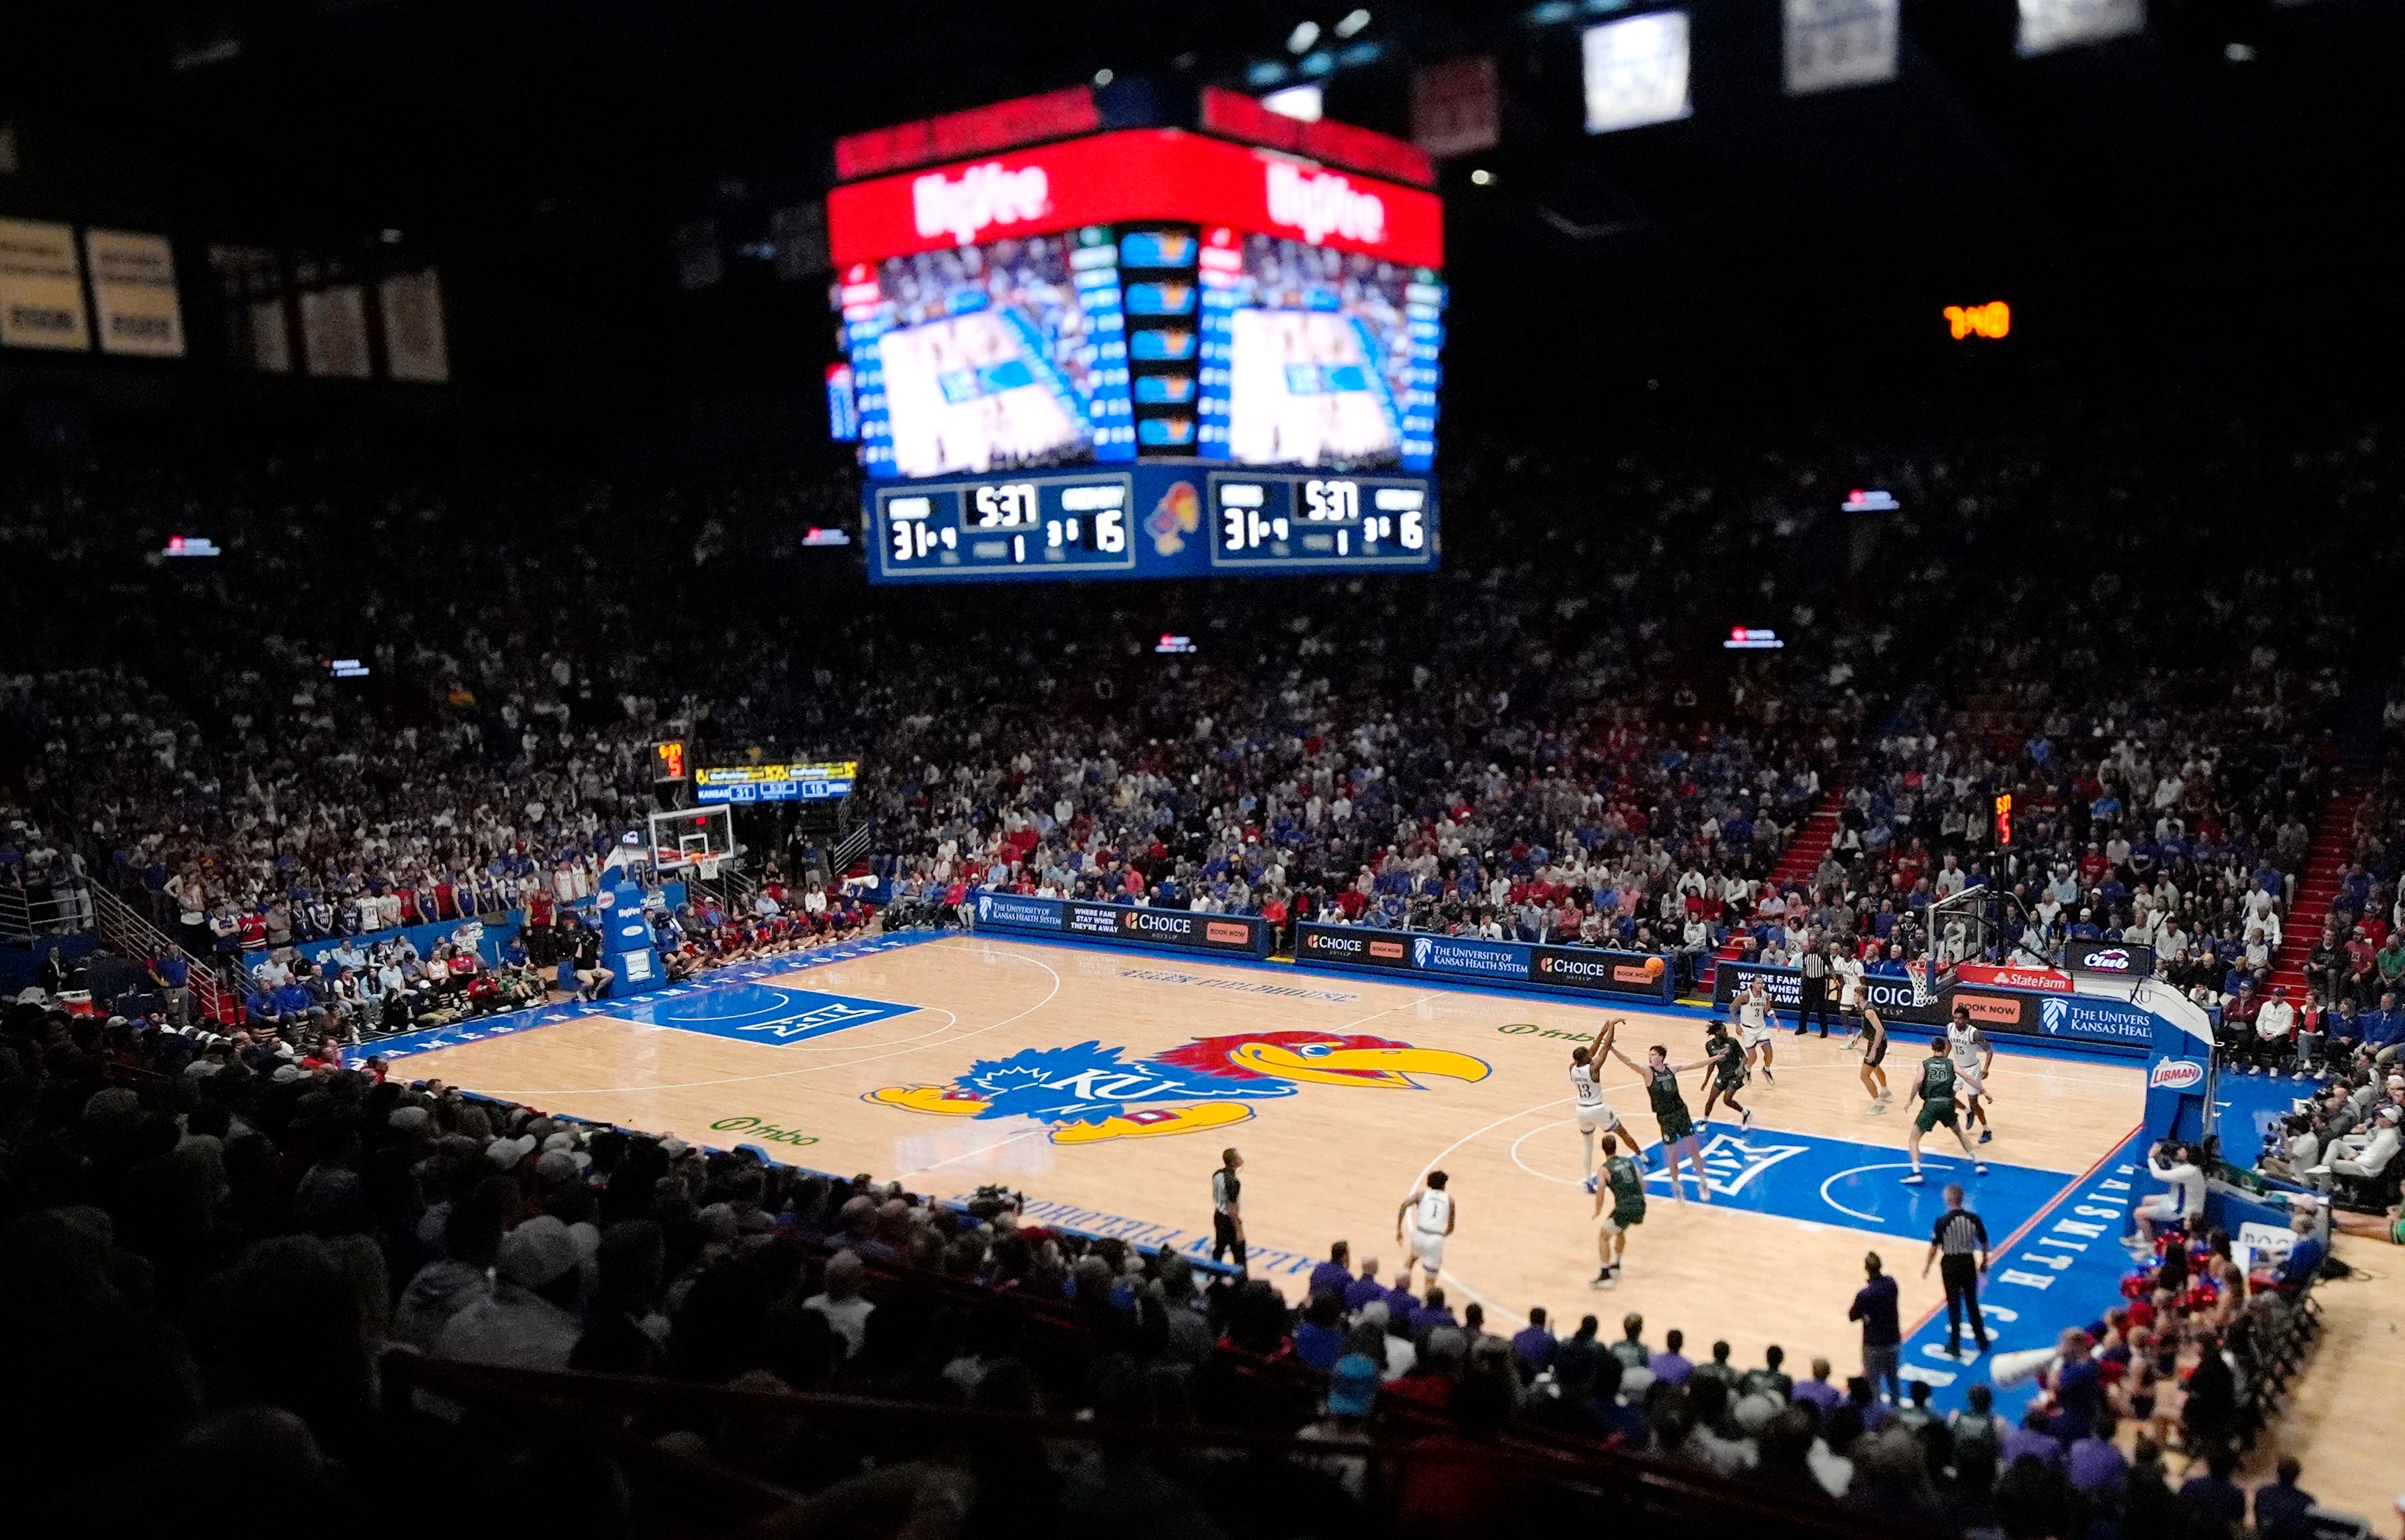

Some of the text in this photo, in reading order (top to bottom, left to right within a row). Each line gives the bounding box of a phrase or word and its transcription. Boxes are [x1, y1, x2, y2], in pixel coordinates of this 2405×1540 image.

[1224, 507, 1260, 550] 31
[892, 521, 927, 561] 31
[993, 903, 1007, 912] THE
[1007, 904, 1041, 916] UNIVERSITY
[1075, 908, 1116, 918] WHERE FANS
[993, 911, 1061, 925] KANSAS HEALTH SYSTEM
[1076, 915, 1114, 925] STAY WHEN
[1139, 914, 1192, 934] CHOICE
[1098, 924, 1119, 933] AWAY
[1319, 936, 1362, 952] CHOICE
[789, 941, 906, 968] COURT
[1434, 945, 1513, 962] THE UNIVERSITY OF
[2084, 952, 2129, 970] Club
[1434, 955, 1528, 973] KANSAS HEALTH SYSTEM
[1554, 959, 1604, 977] CHOICE
[1737, 971, 1774, 983] WHRE
[1768, 984, 1799, 995] WHEN
[1867, 985, 1925, 1008] OICE
[2130, 989, 2152, 1005] KU
[1775, 994, 1803, 1004] AWA
[1754, 1008, 1760, 1017] 3
[1958, 1002, 2015, 1015] BOOK NOW
[2071, 1008, 2096, 1020] THE
[2071, 1019, 2116, 1033] KANSAS
[1955, 1045, 1965, 1055] 15
[1929, 1068, 1948, 1081] 20
[2153, 1068, 2196, 1084] LIBMAN
[1039, 1068, 1186, 1101] KU
[1577, 1083, 1592, 1098] 13
[743, 1124, 820, 1146] fnbo
